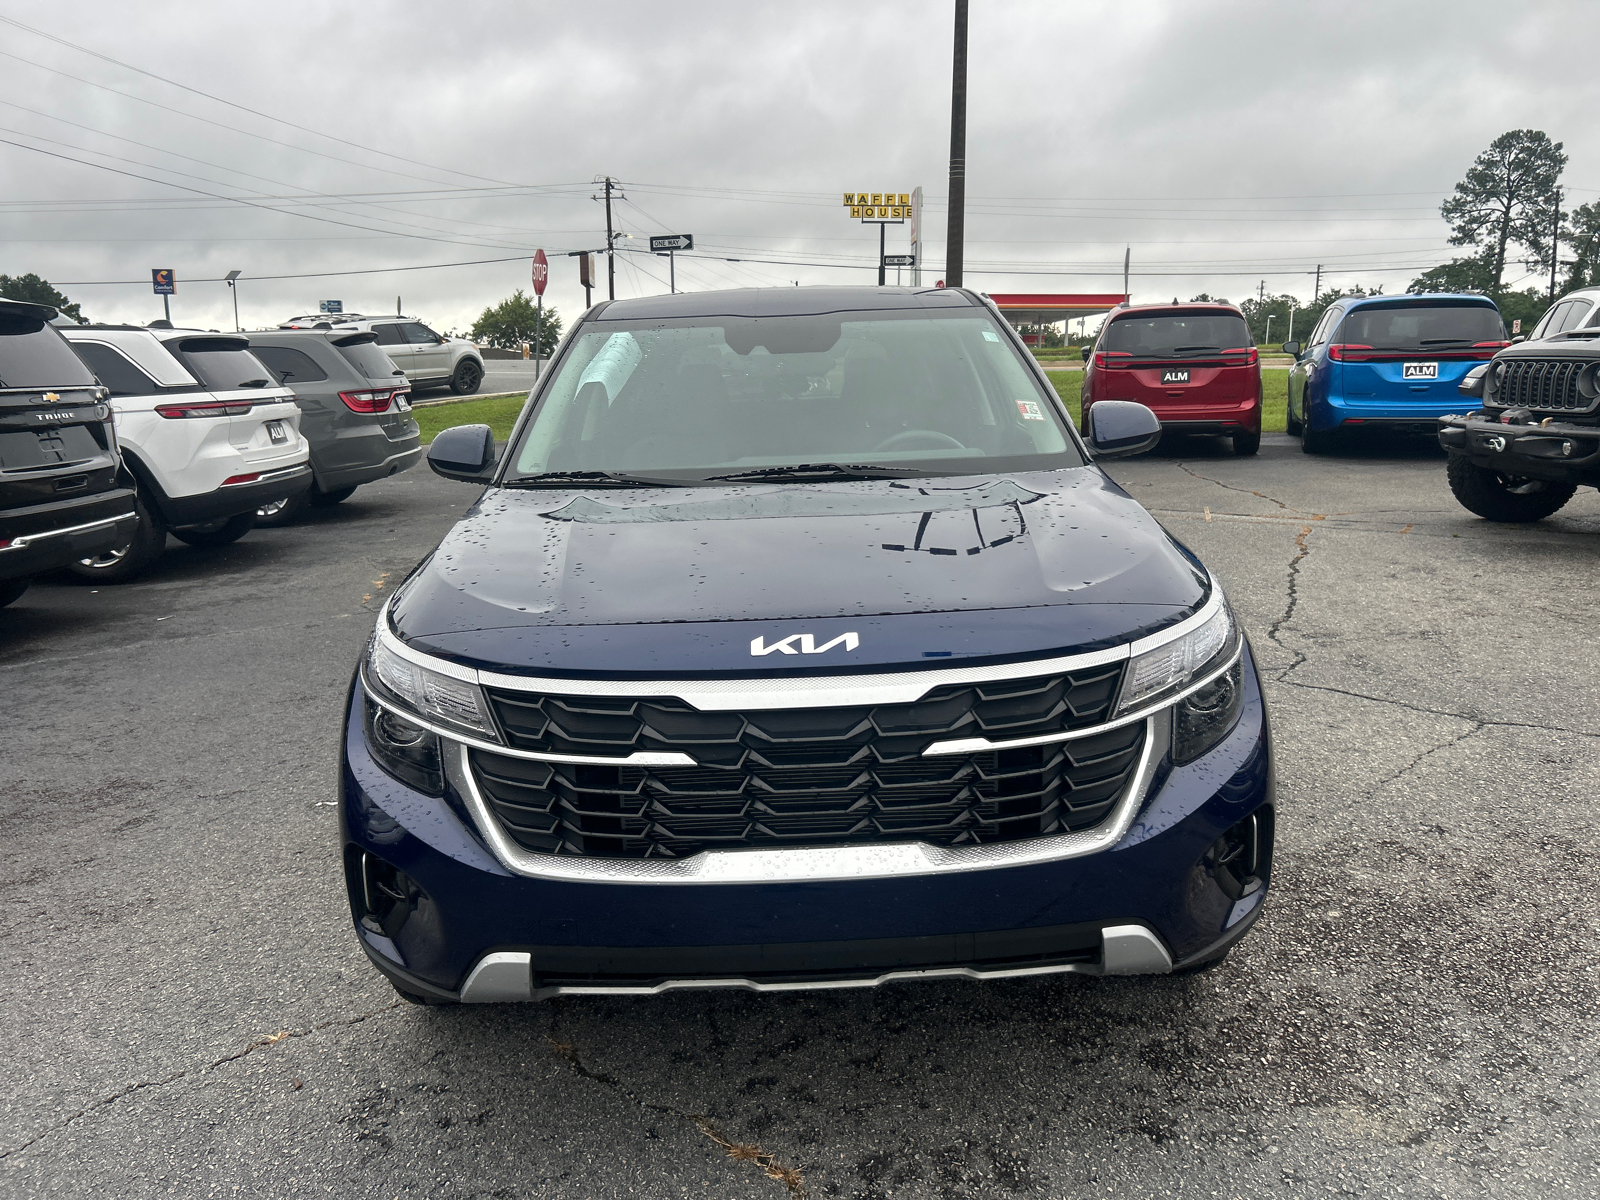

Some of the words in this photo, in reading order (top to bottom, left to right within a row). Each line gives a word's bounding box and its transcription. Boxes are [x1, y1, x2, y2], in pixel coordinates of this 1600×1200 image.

[845, 194, 907, 204] WAFFL
[852, 208, 912, 217] HOUSE
[532, 263, 547, 281] STOP
[1407, 367, 1434, 376] ALM
[1163, 372, 1188, 381] ALM
[35, 412, 75, 421] TAHOE
[271, 427, 286, 439] ALM
[750, 632, 859, 656] KIA
